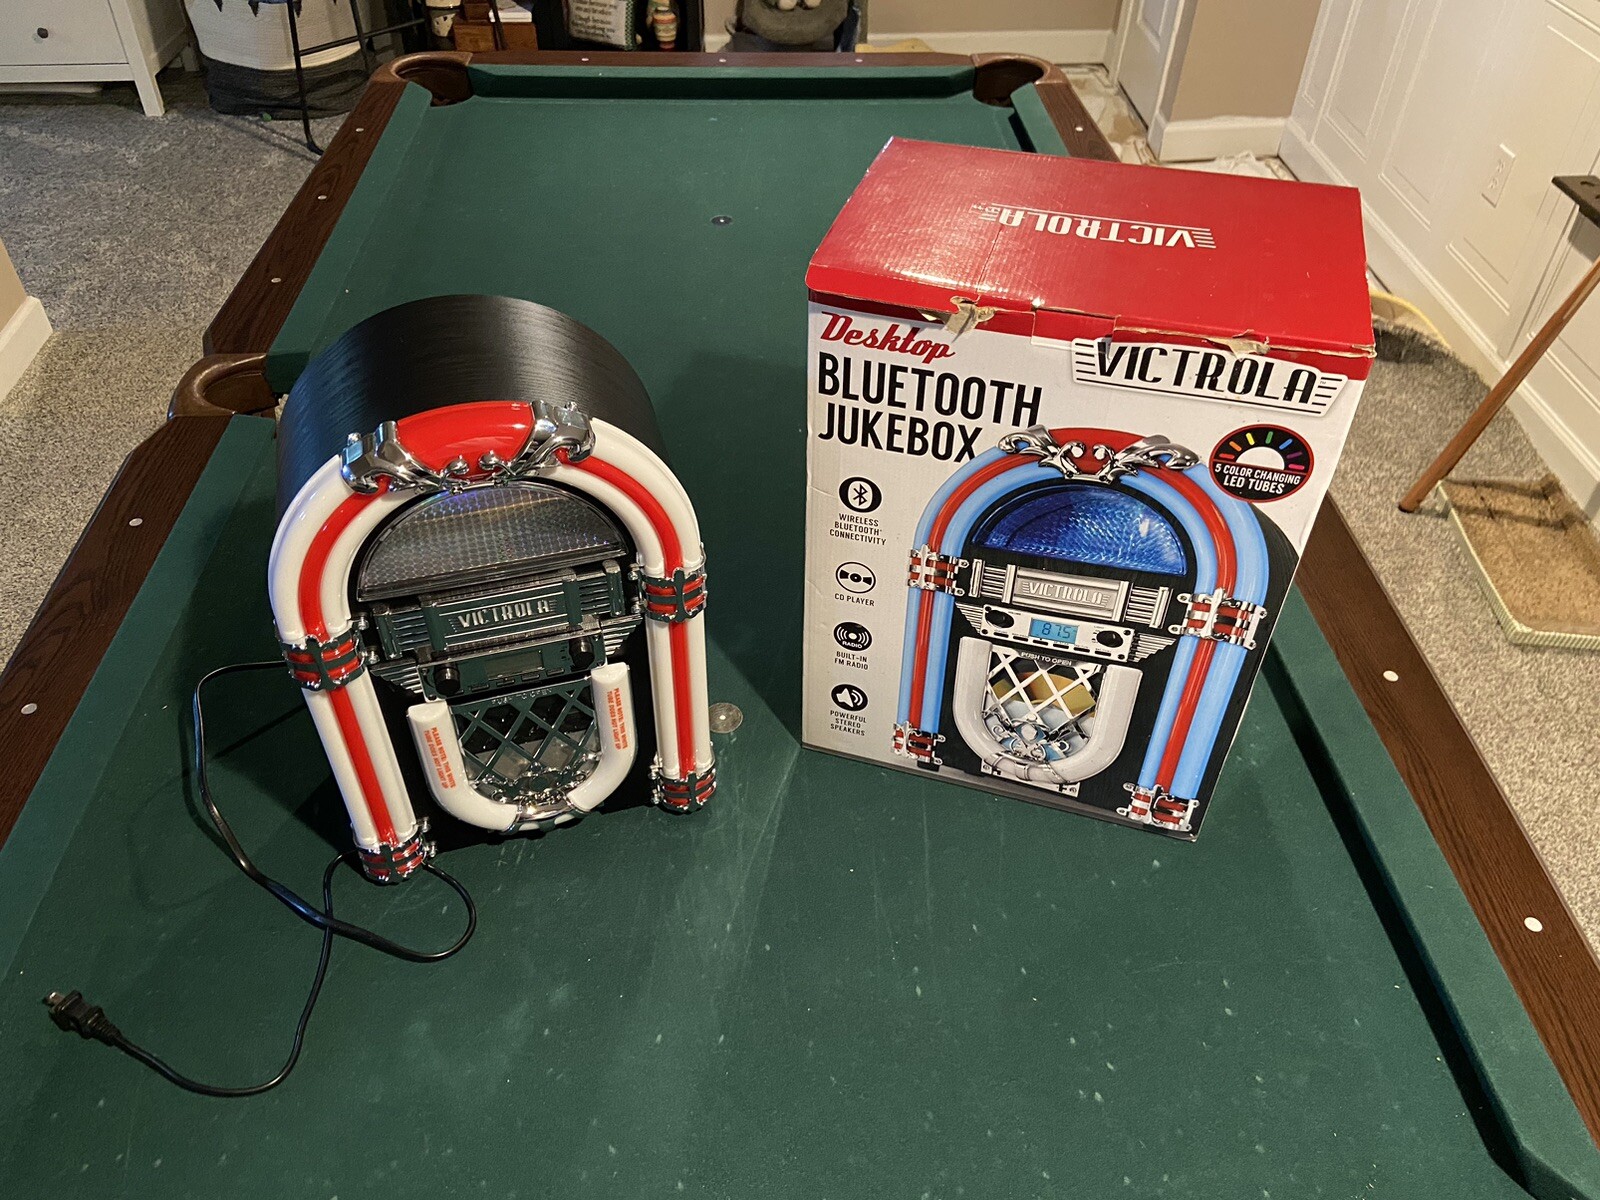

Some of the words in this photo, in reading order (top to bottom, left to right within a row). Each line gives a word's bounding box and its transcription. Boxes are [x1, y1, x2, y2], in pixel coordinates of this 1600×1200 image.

[999, 209, 1195, 248] VICTROLA
[820, 311, 956, 364] Desktop
[1097, 341, 1318, 404] VICTROLA
[818, 351, 1043, 428] BLUETOOTH
[817, 402, 983, 463] JUKEBOX
[1215, 463, 1222, 473] 5
[1223, 465, 1252, 478] COLOR
[1254, 470, 1301, 485] CHANGING
[1223, 474, 1245, 489] LED
[1248, 478, 1285, 495] TUBES
[838, 513, 879, 527] WIRELESS
[834, 521, 882, 536] BLUETOOTH
[829, 529, 887, 546] CONNECTIVITY
[834, 593, 845, 601] CD
[846, 595, 875, 607] PLAYER
[1029, 582, 1103, 604] VICTROLA
[458, 599, 550, 628] VICTROLA
[842, 640, 863, 649] RADIO
[834, 658, 845, 666] FM
[846, 660, 869, 671] RADIO
[836, 651, 868, 663] BUILT-IN
[1021, 652, 1040, 660] PUSH
[1041, 655, 1051, 663] TO
[1051, 658, 1072, 666] OPEN
[830, 710, 867, 723] POWERFUL
[835, 718, 861, 728] STEREO
[830, 723, 865, 736] SPEAKERS
